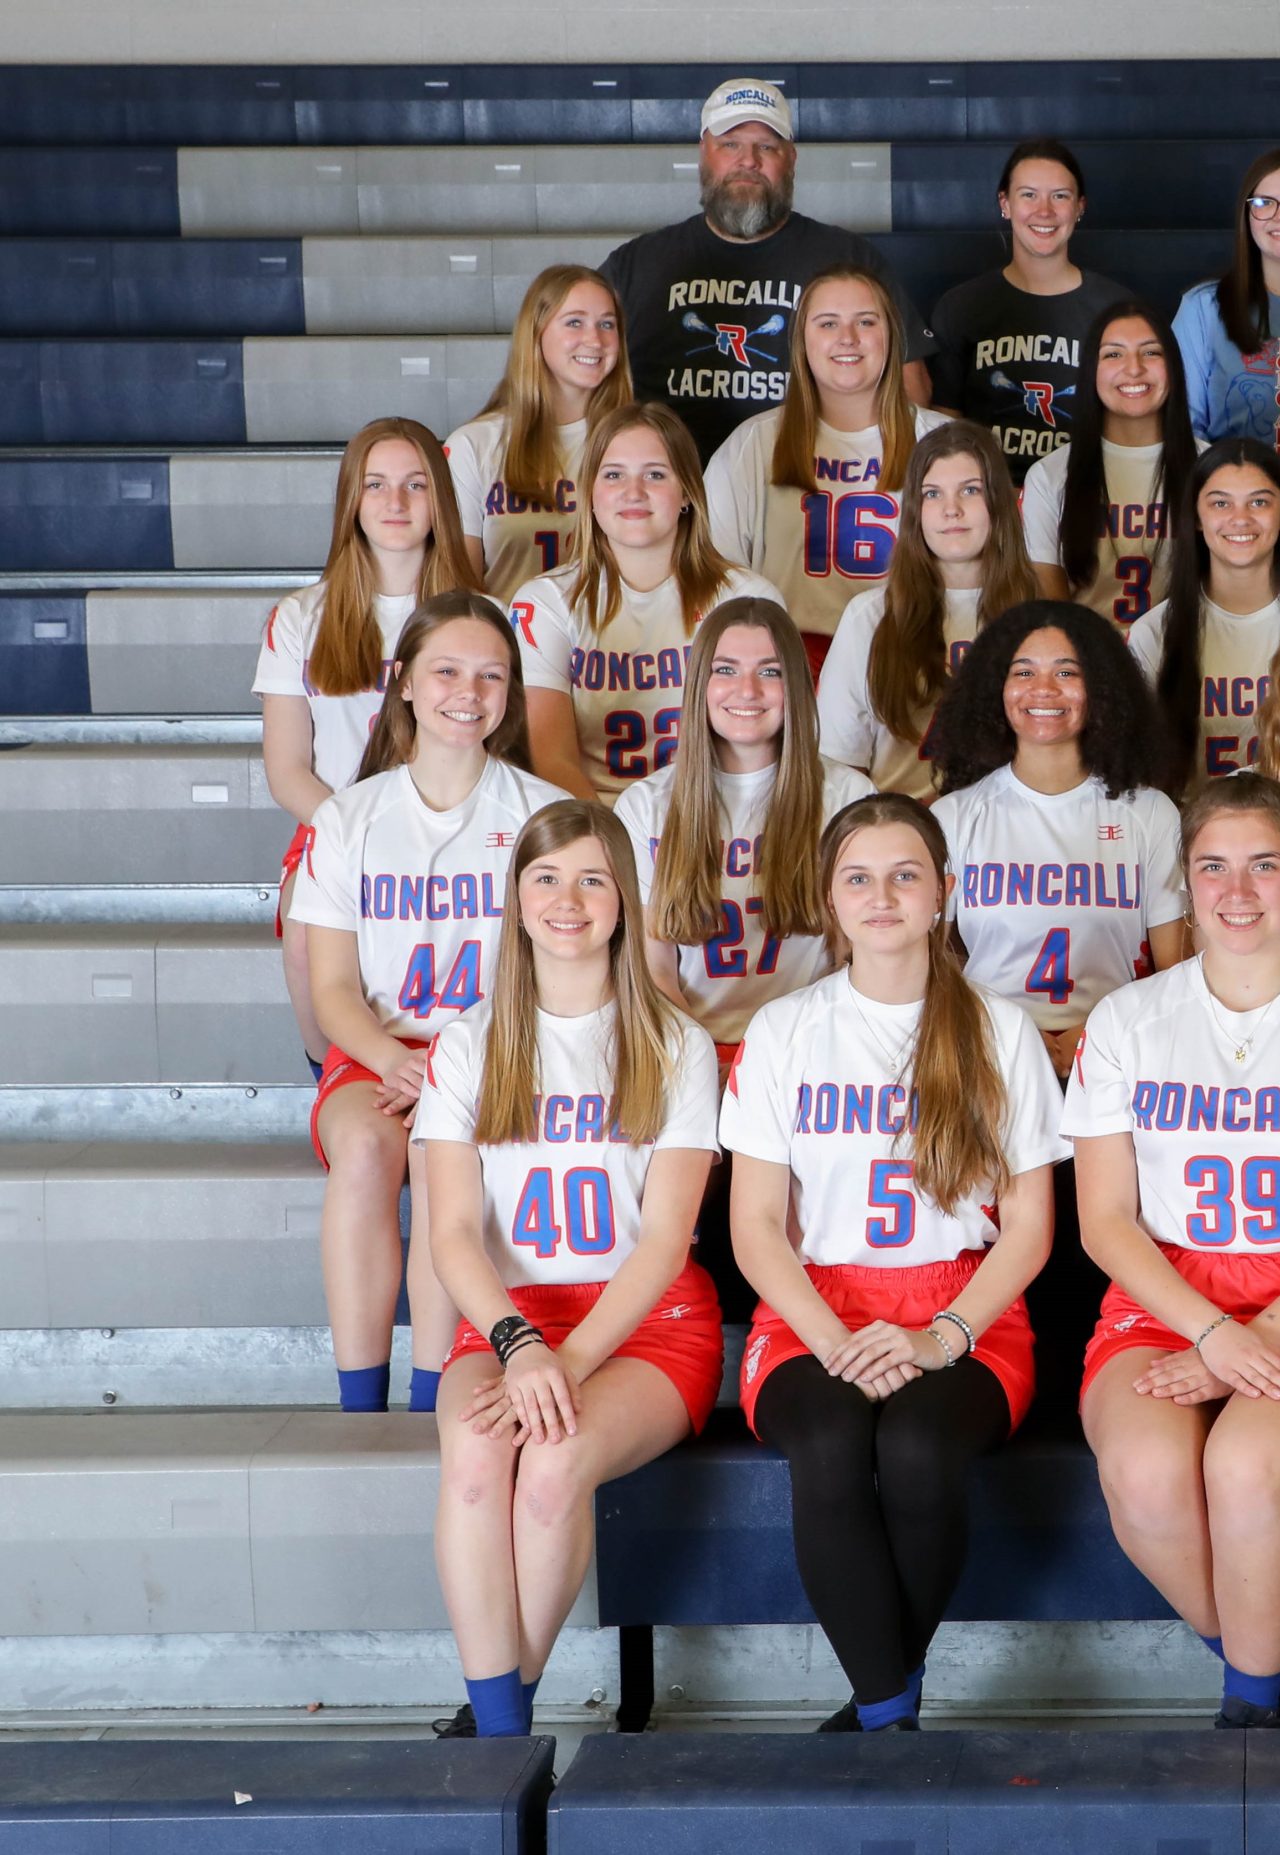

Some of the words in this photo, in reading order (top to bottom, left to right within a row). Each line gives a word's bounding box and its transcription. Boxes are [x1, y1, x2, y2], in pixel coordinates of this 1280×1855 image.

[668, 278, 802, 312] RONCALLI
[976, 334, 1080, 370] RONCAL
[667, 368, 791, 400] LACROSS
[991, 425, 1072, 456] ACROS
[800, 490, 898, 580] 16
[570, 646, 692, 692] RONCA
[604, 707, 683, 778] 22
[361, 872, 505, 921] RONCAL
[398, 939, 485, 1019] 44
[1025, 927, 1075, 1004] 4
[512, 1166, 616, 1259] 40
[865, 1158, 917, 1248] 5
